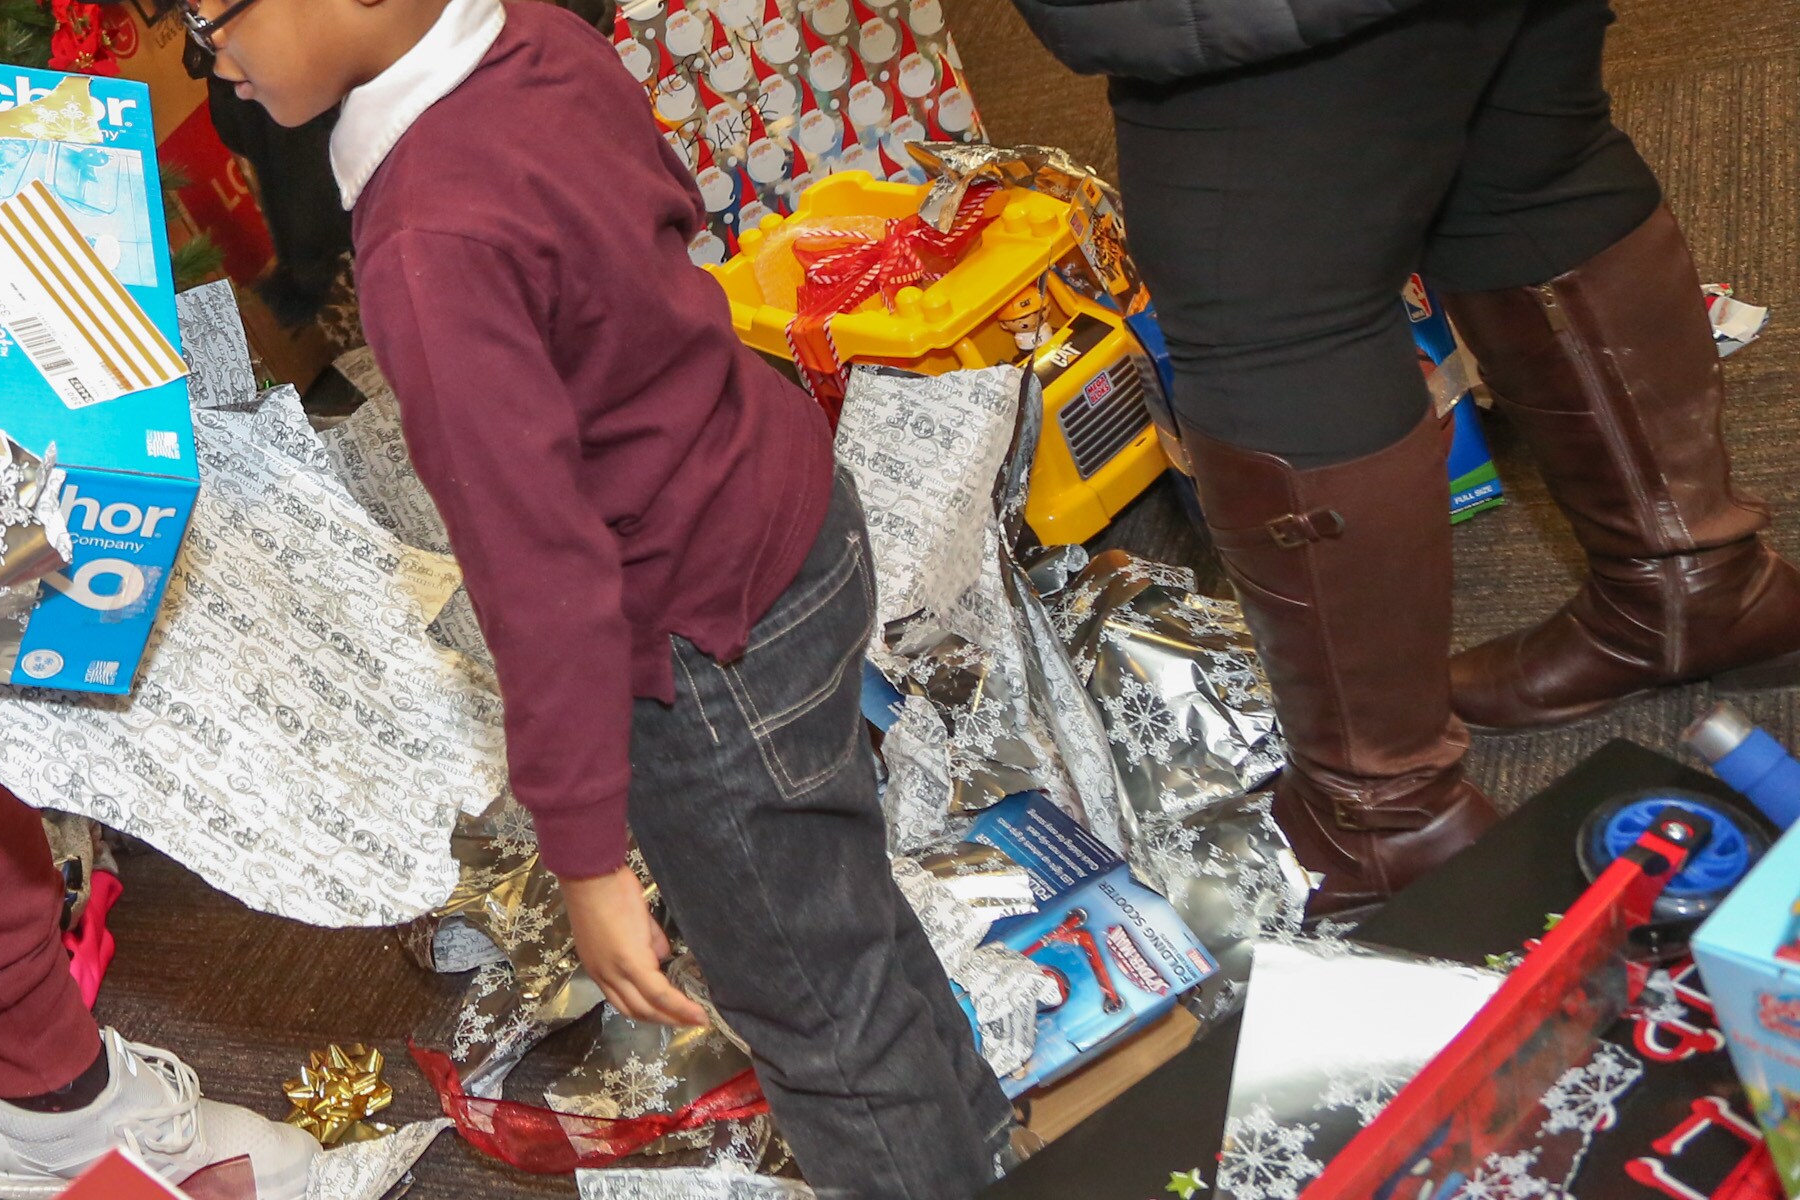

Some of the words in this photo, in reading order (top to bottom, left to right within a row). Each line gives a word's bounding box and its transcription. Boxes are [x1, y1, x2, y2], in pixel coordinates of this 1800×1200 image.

[673, 92, 778, 168] BAKER
[1019, 297, 1031, 308] CAT
[1049, 340, 1081, 367] CAT
[1084, 372, 1108, 394] MEGA
[1088, 382, 1111, 403] BLOKS
[885, 403, 963, 452] JOY
[1454, 491, 1474, 504] FULL
[1474, 485, 1492, 497] SIZE
[1055, 831, 1066, 843] for
[1062, 838, 1084, 859] folding
[1080, 854, 1099, 872] Quick
[1098, 880, 1146, 927] SCOOTER
[1143, 926, 1192, 984] FOLDING
